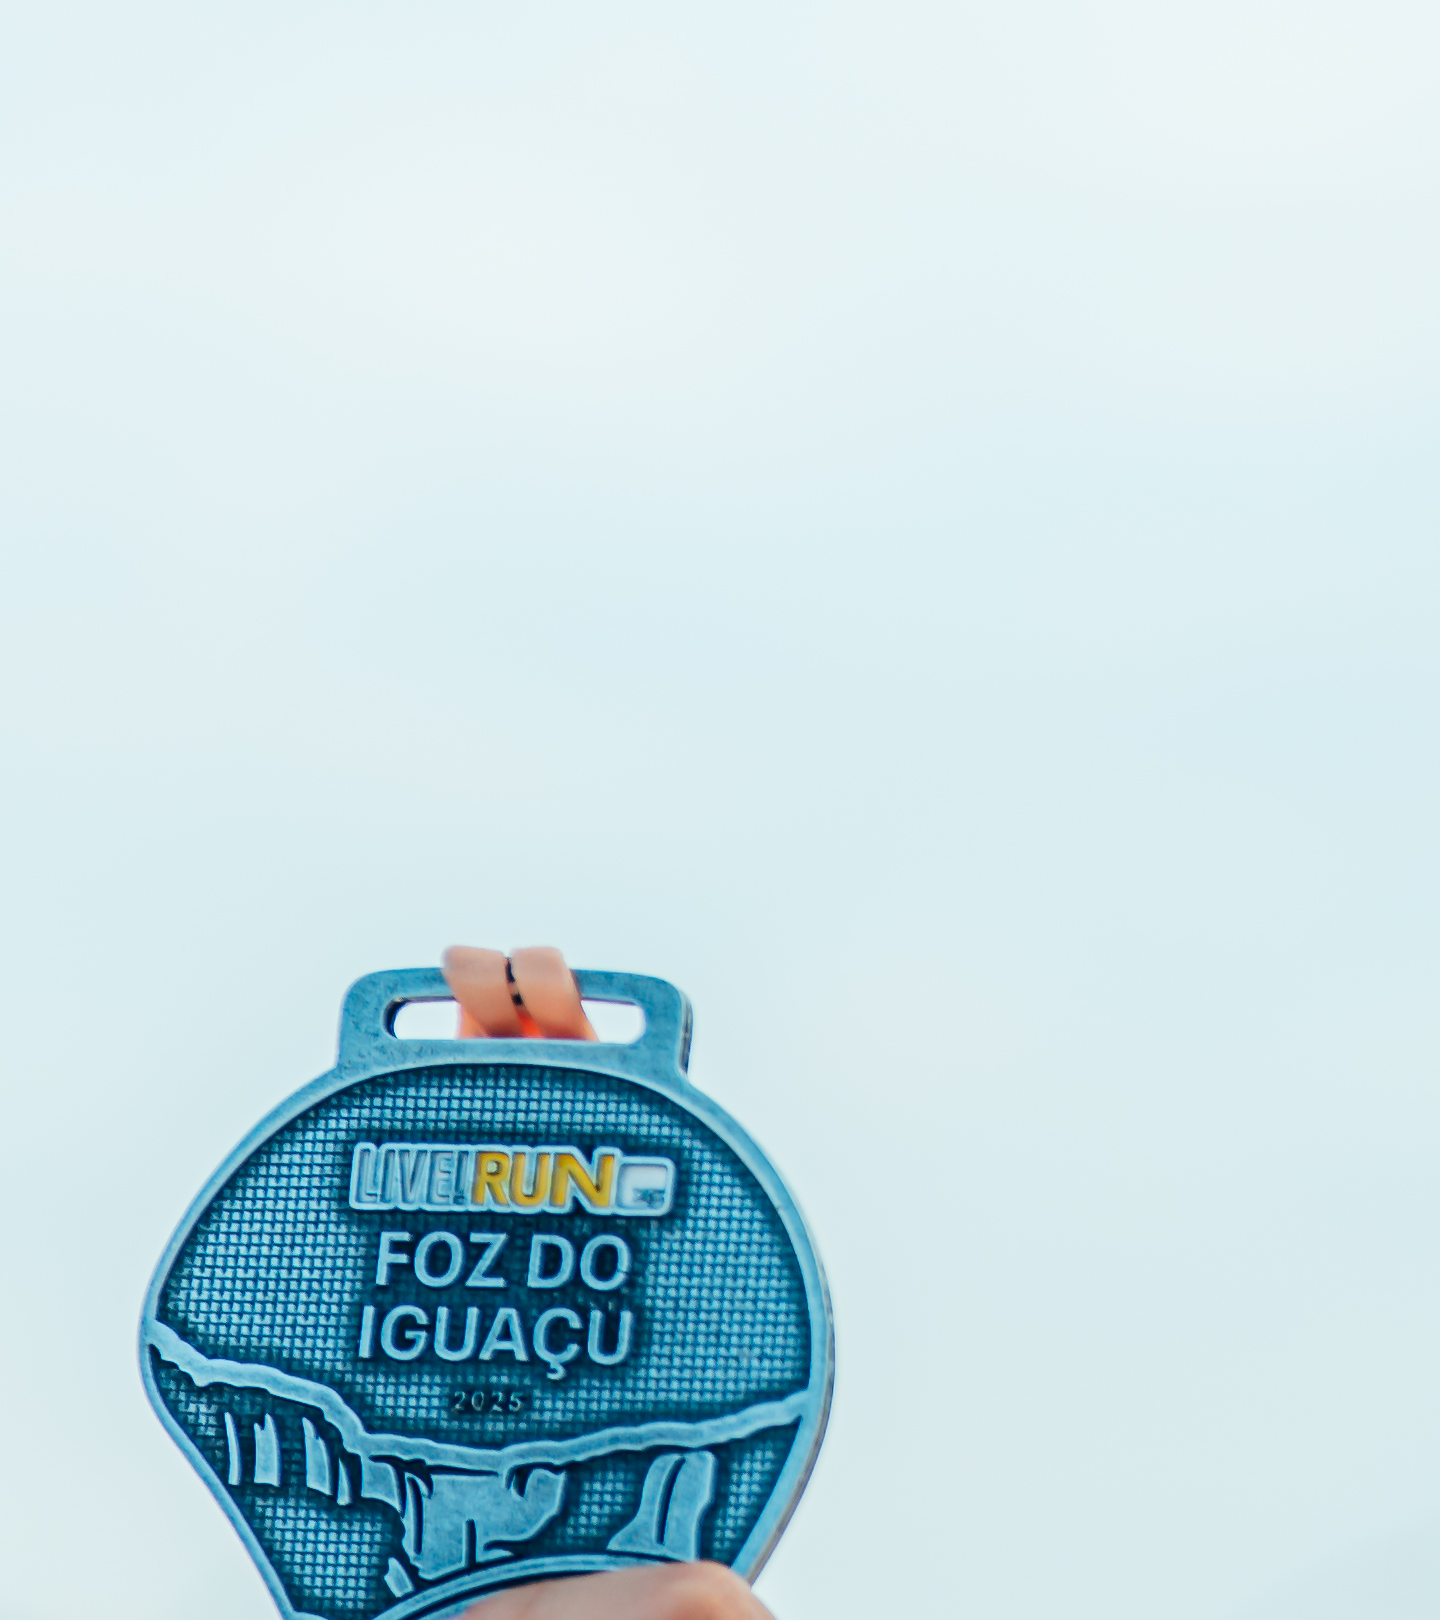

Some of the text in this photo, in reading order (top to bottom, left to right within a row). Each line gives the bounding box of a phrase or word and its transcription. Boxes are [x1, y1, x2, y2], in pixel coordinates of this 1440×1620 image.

[375, 1231, 632, 1291] FOZ DO
[358, 1304, 634, 1380] IGUAÇU
[453, 1390, 523, 1412] 2025
